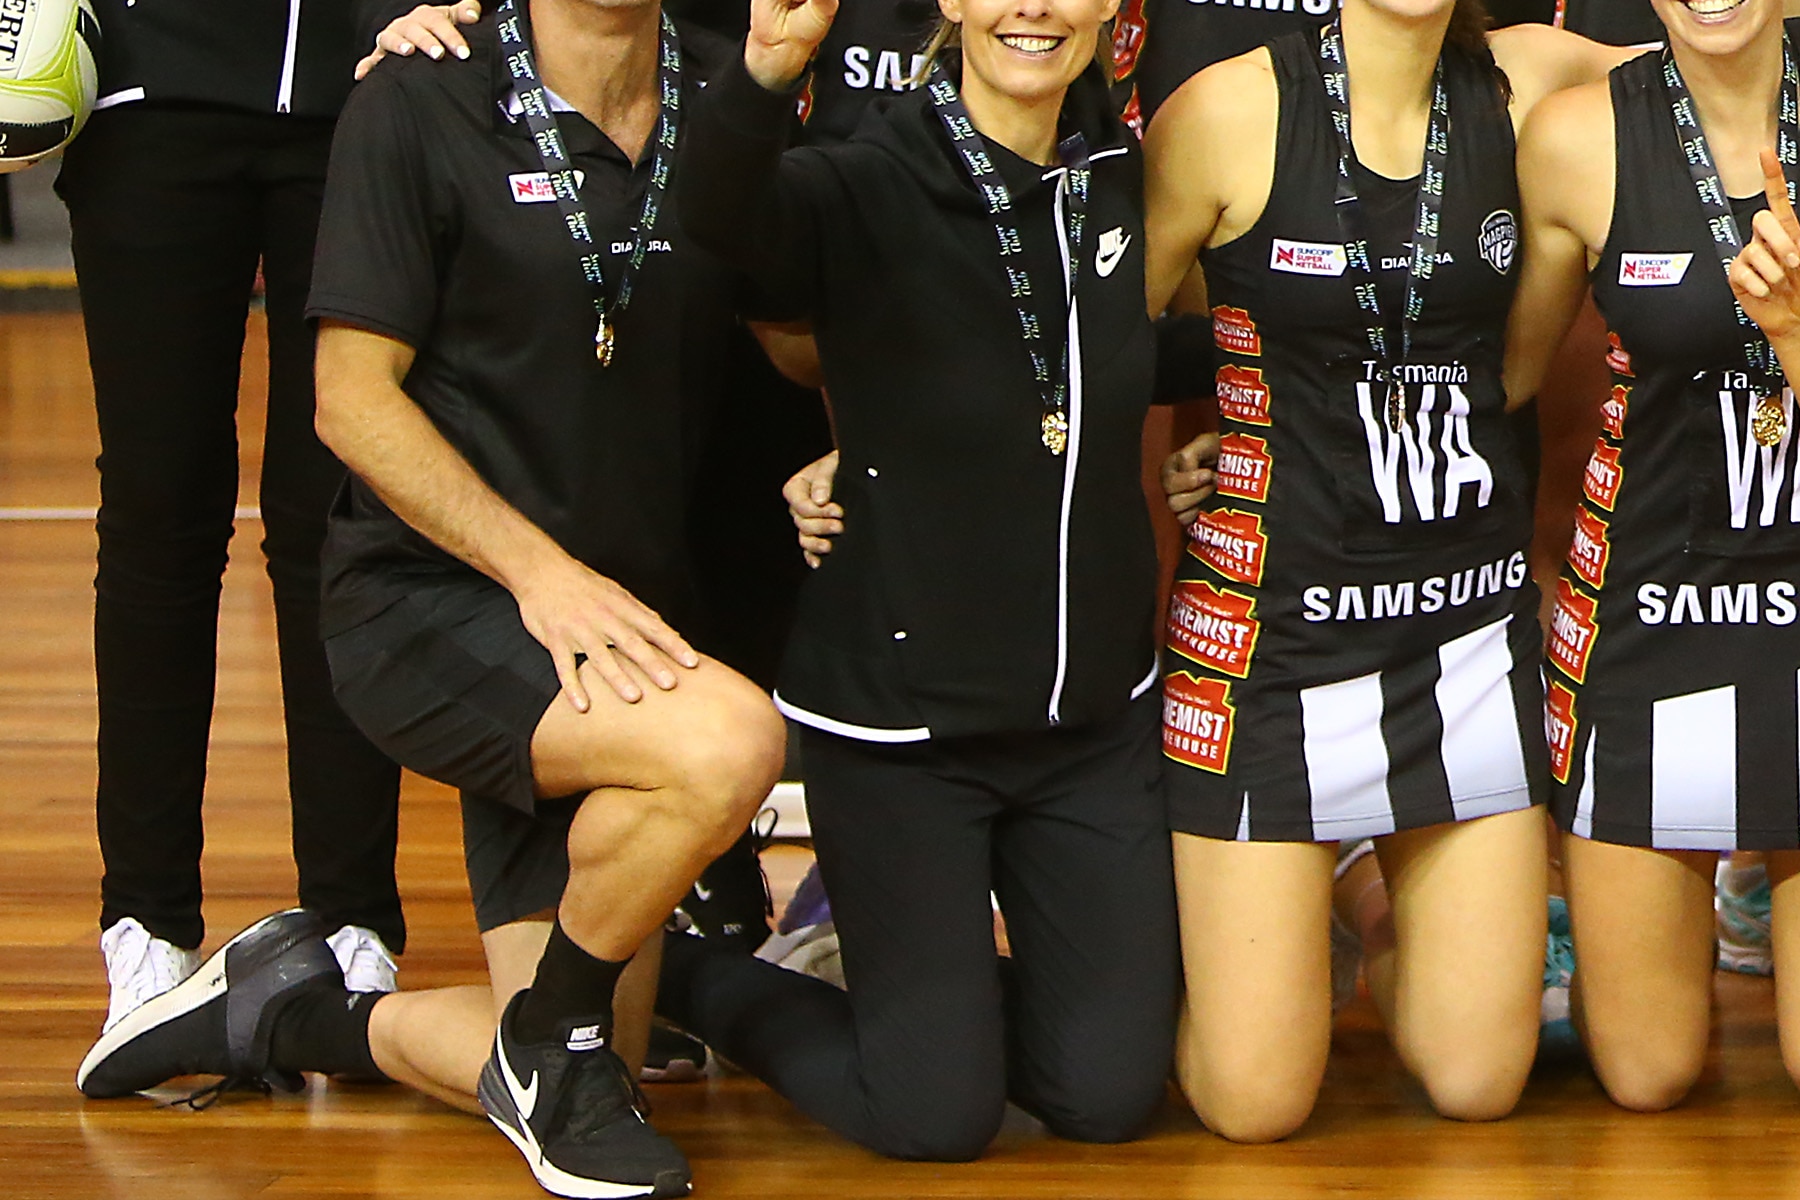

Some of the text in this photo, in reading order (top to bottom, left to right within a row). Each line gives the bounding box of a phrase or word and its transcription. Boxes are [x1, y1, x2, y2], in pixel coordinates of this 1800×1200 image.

[532, 88, 549, 119] Super
[547, 129, 564, 160] Super
[1693, 136, 1710, 167] Super
[1422, 161, 1434, 194] Super
[1706, 175, 1723, 207] Super
[982, 183, 1001, 214] Super
[611, 240, 672, 254] DIARA
[1296, 254, 1323, 264] SUPER
[1297, 247, 1334, 256] SUNCORP
[1381, 251, 1454, 270] DIARA
[1295, 261, 1333, 271] NETBALL
[1218, 453, 1266, 479] EMIST
[1356, 381, 1493, 523] WA
[1188, 521, 1259, 564] HEMIST
[1303, 551, 1527, 622] SAMSUNG
[1551, 603, 1590, 653] EMIST
[1164, 730, 1219, 760] EHOUSE
